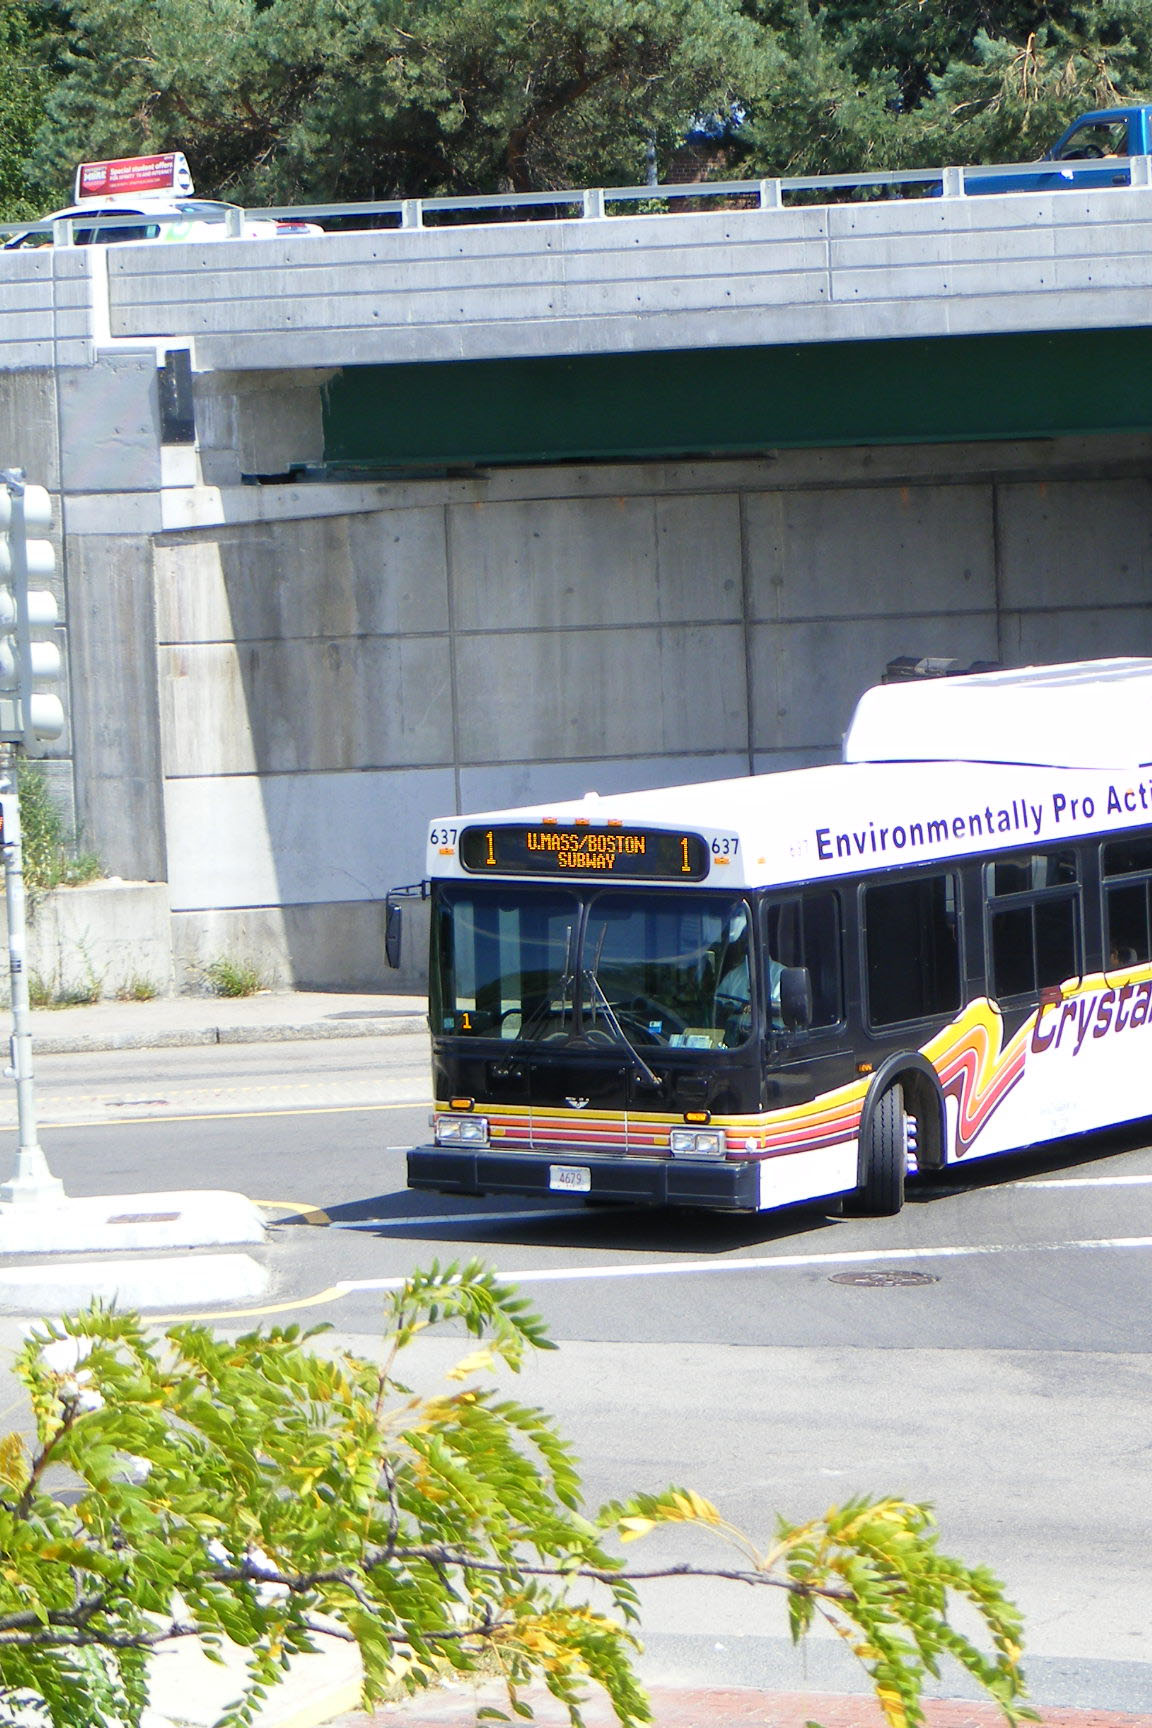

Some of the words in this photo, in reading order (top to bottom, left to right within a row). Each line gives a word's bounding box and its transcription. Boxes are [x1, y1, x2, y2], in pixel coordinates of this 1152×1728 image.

[110, 165, 132, 176] Special
[132, 163, 154, 173] student
[816, 798, 1043, 860] Environmentally
[1052, 793, 1095, 823] Pro
[430, 829, 457, 845] 637
[527, 832, 646, 854] U.MASS/BOSTON
[485, 831, 497, 865] 1
[680, 837, 691, 872] 1
[711, 838, 739, 855] 637
[558, 852, 616, 869] SUBWAY
[461, 1012, 473, 1030] 1
[559, 1172, 582, 1184] 4679
